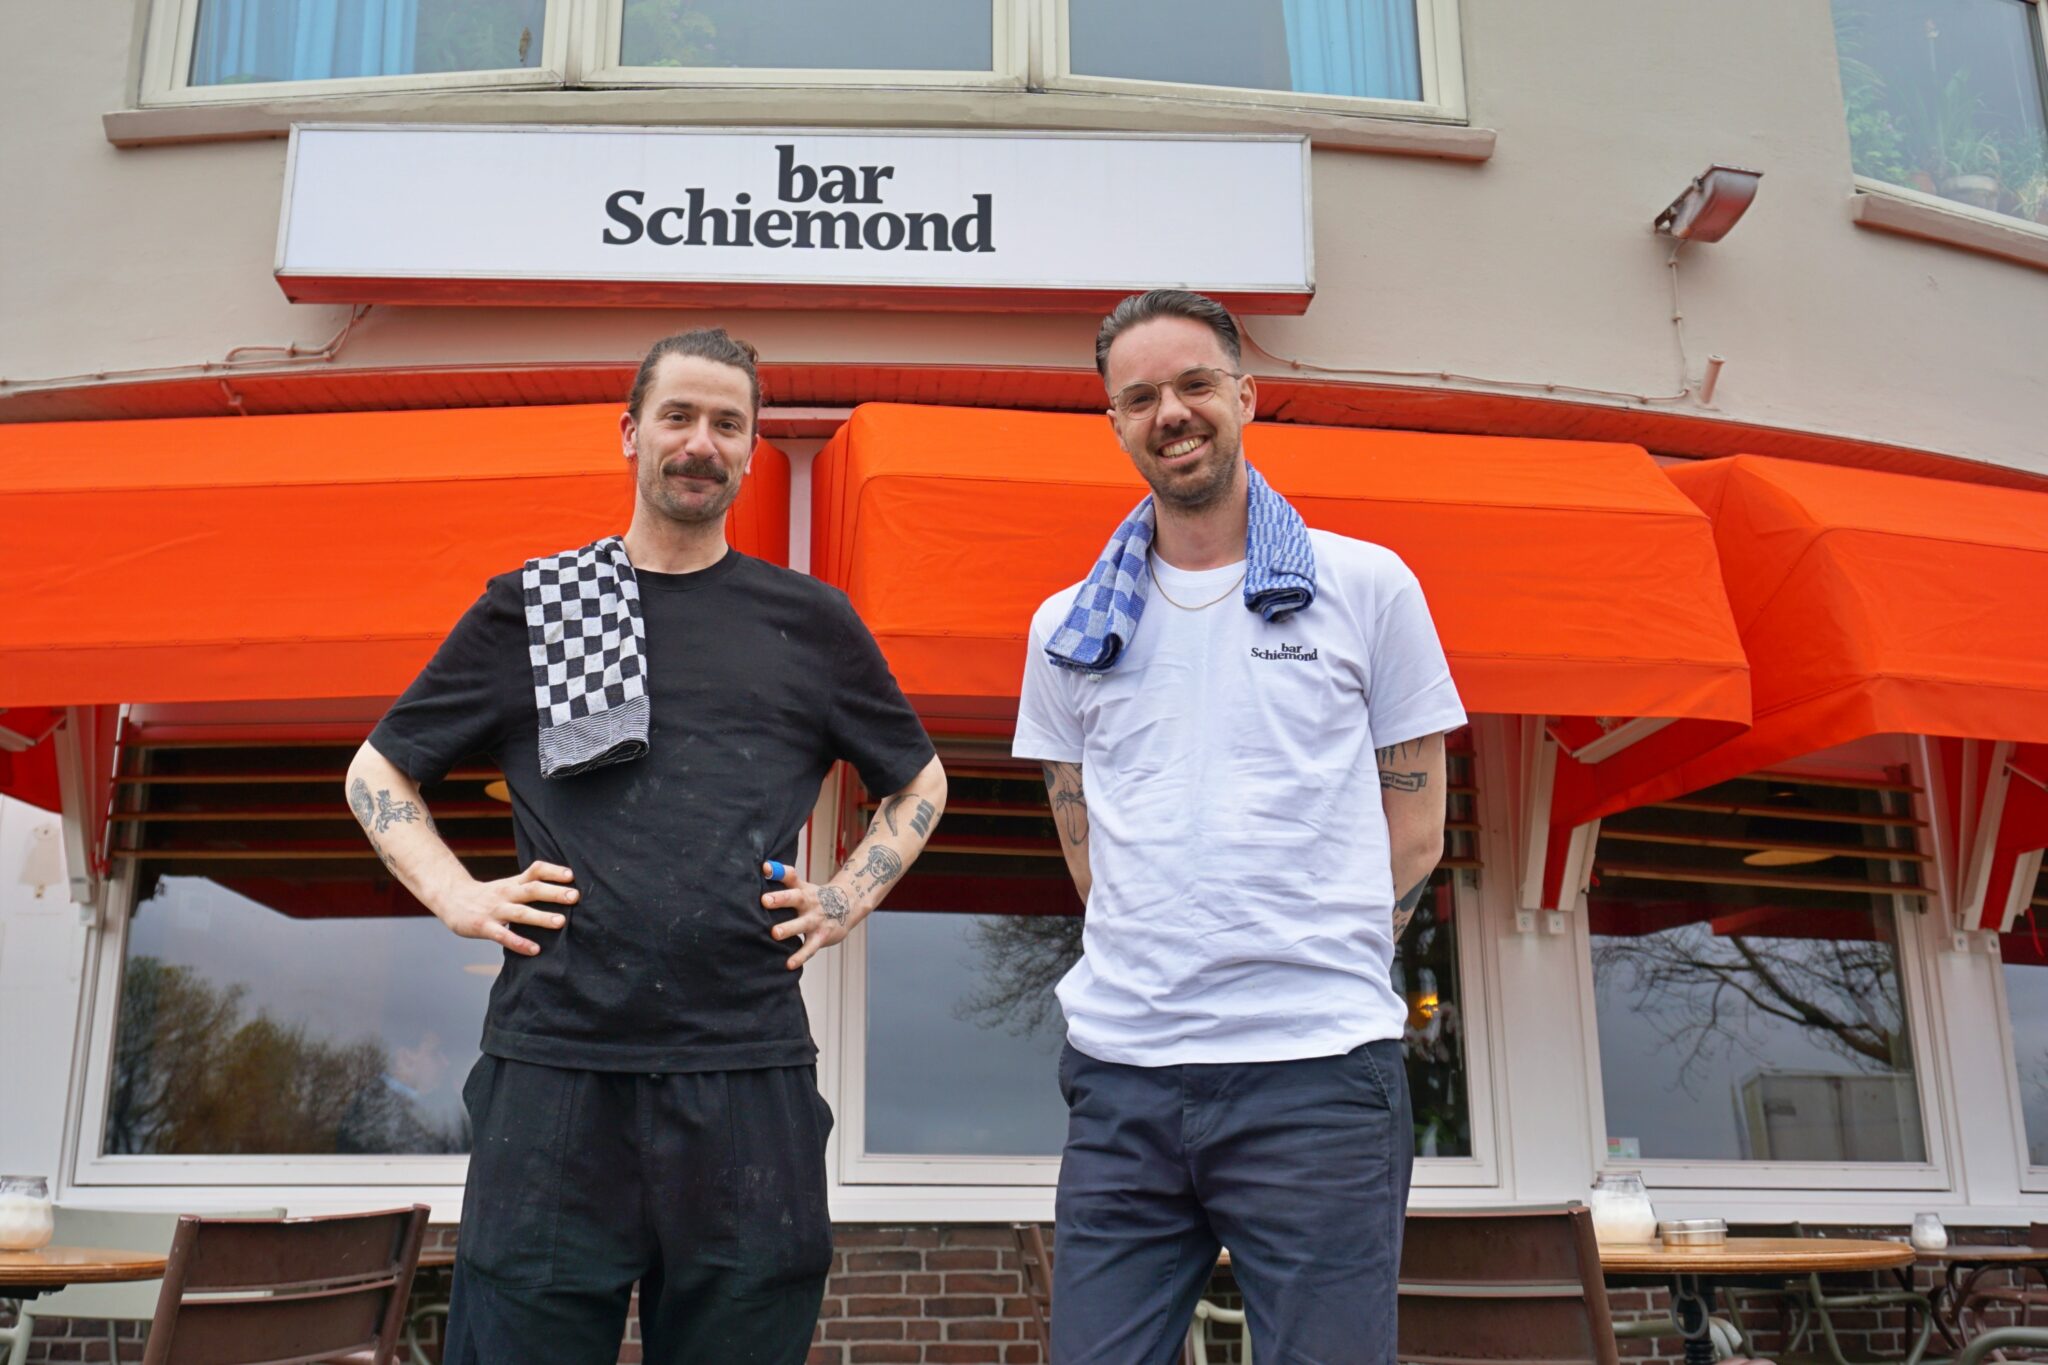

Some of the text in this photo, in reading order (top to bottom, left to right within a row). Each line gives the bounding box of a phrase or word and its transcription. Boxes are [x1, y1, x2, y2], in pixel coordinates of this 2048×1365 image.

[775, 144, 895, 204] bar
[602, 187, 996, 253] Schiemond
[1251, 647, 1318, 661] Schiemond
[1281, 643, 1302, 653] bar
